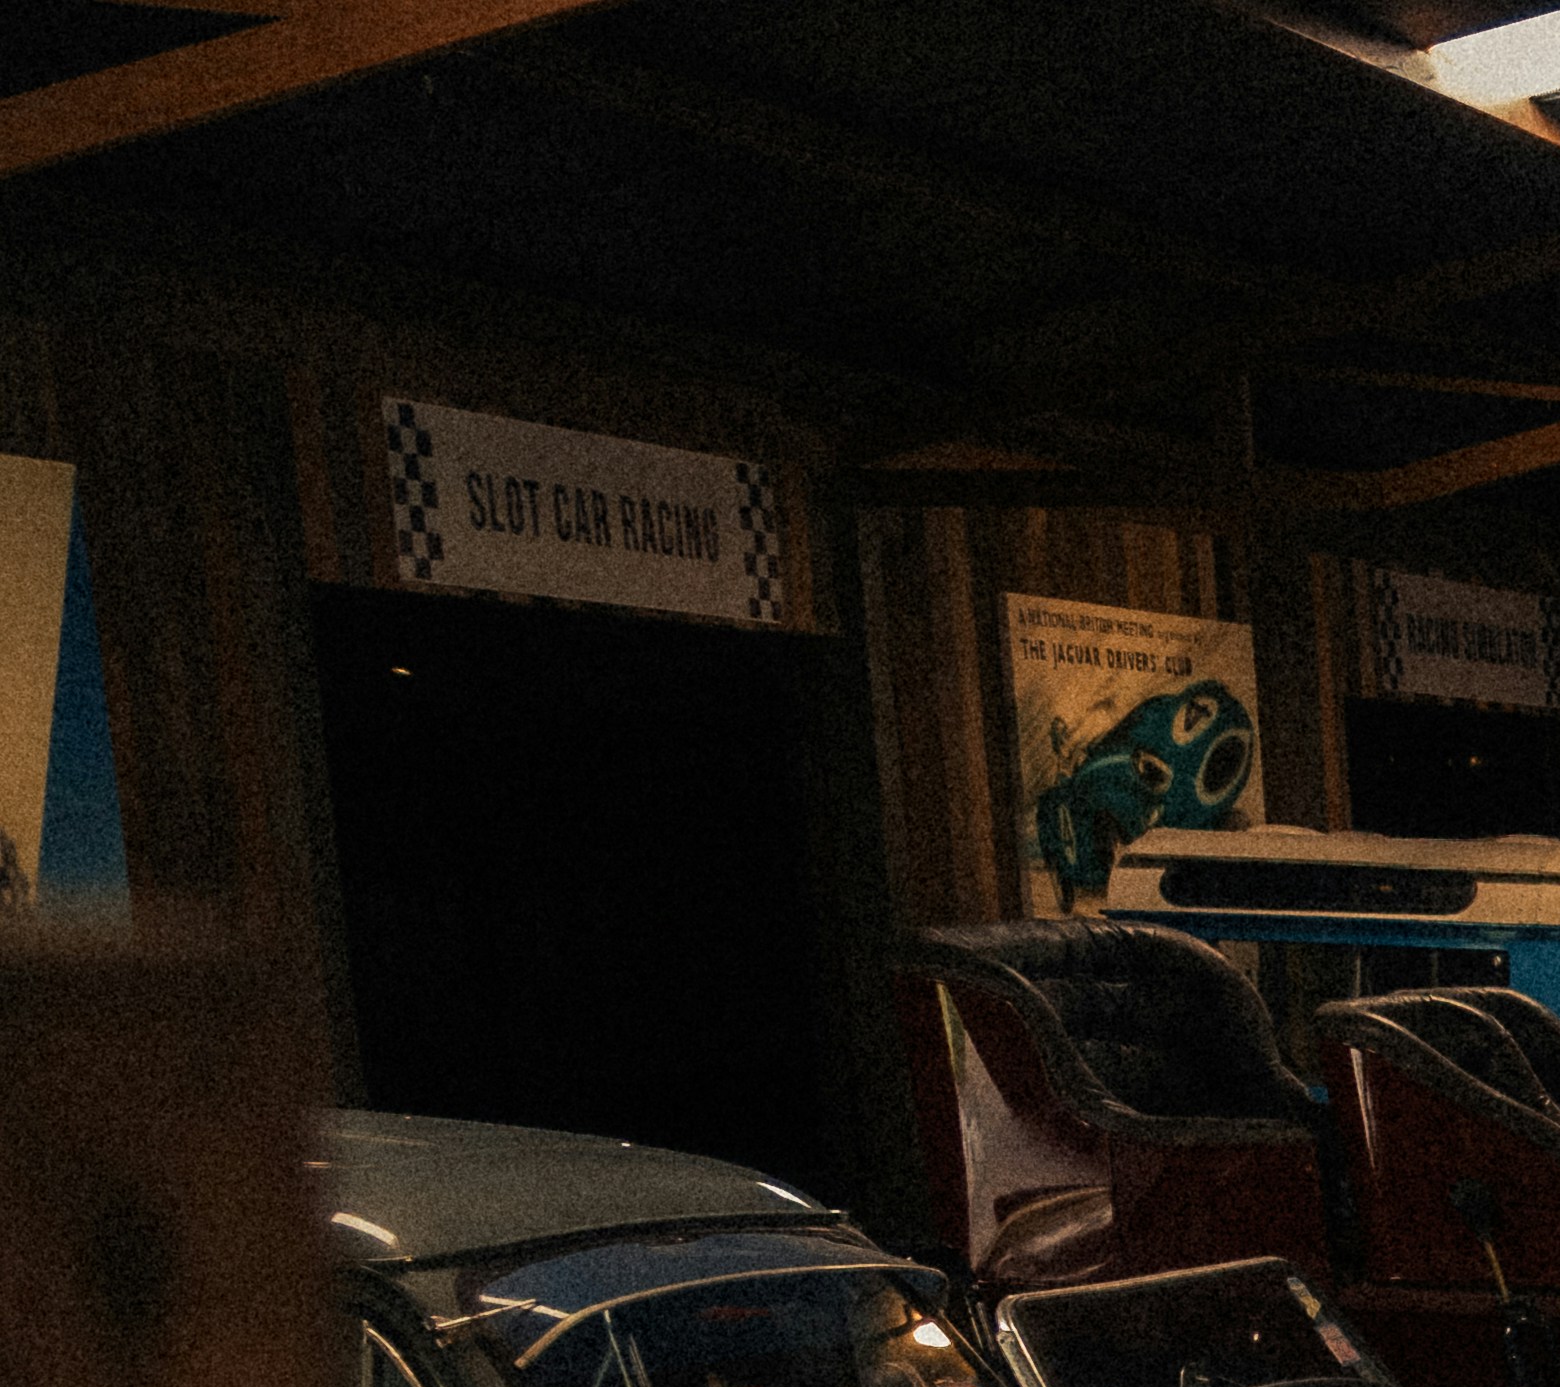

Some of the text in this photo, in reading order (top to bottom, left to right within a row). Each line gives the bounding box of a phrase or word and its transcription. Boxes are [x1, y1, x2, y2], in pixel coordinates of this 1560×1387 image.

[466, 471, 720, 563] SLOT CAR RACING
[1019, 638, 1047, 661] THE
[1051, 642, 1102, 670] JAGUAR
[1164, 655, 1194, 677] CLUB
